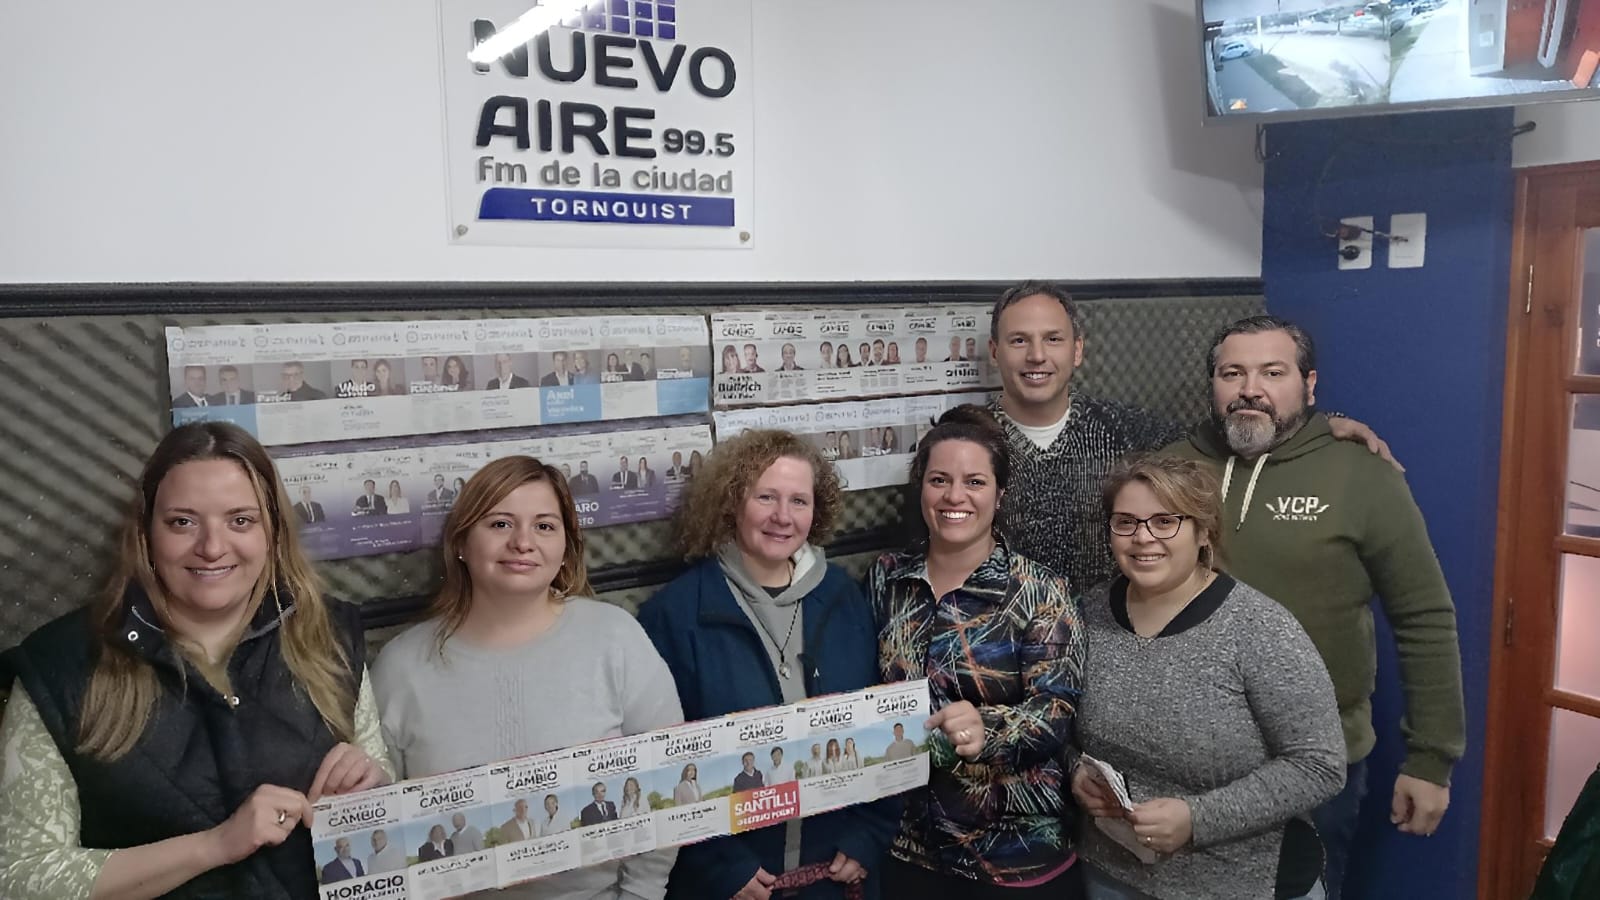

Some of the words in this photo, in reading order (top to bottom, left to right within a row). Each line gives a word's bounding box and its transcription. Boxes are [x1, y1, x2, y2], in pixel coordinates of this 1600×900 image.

[474, 18, 736, 99] NUEVO
[476, 95, 657, 158] AIRE
[663, 127, 735, 157] 99.5
[478, 156, 527, 184] Fm
[540, 160, 581, 187] de
[593, 162, 621, 189] la
[632, 165, 734, 193] ciudad
[531, 197, 693, 220] TORNQUIST
[1277, 496, 1319, 514] VCP
[588, 754, 637, 773] CAMBIO
[506, 770, 558, 790] CAMBIO
[419, 788, 475, 809] CAMBIO
[734, 790, 797, 816] SANTILLI
[328, 807, 387, 828] CAMBIO
[326, 874, 404, 900] HORACIO
